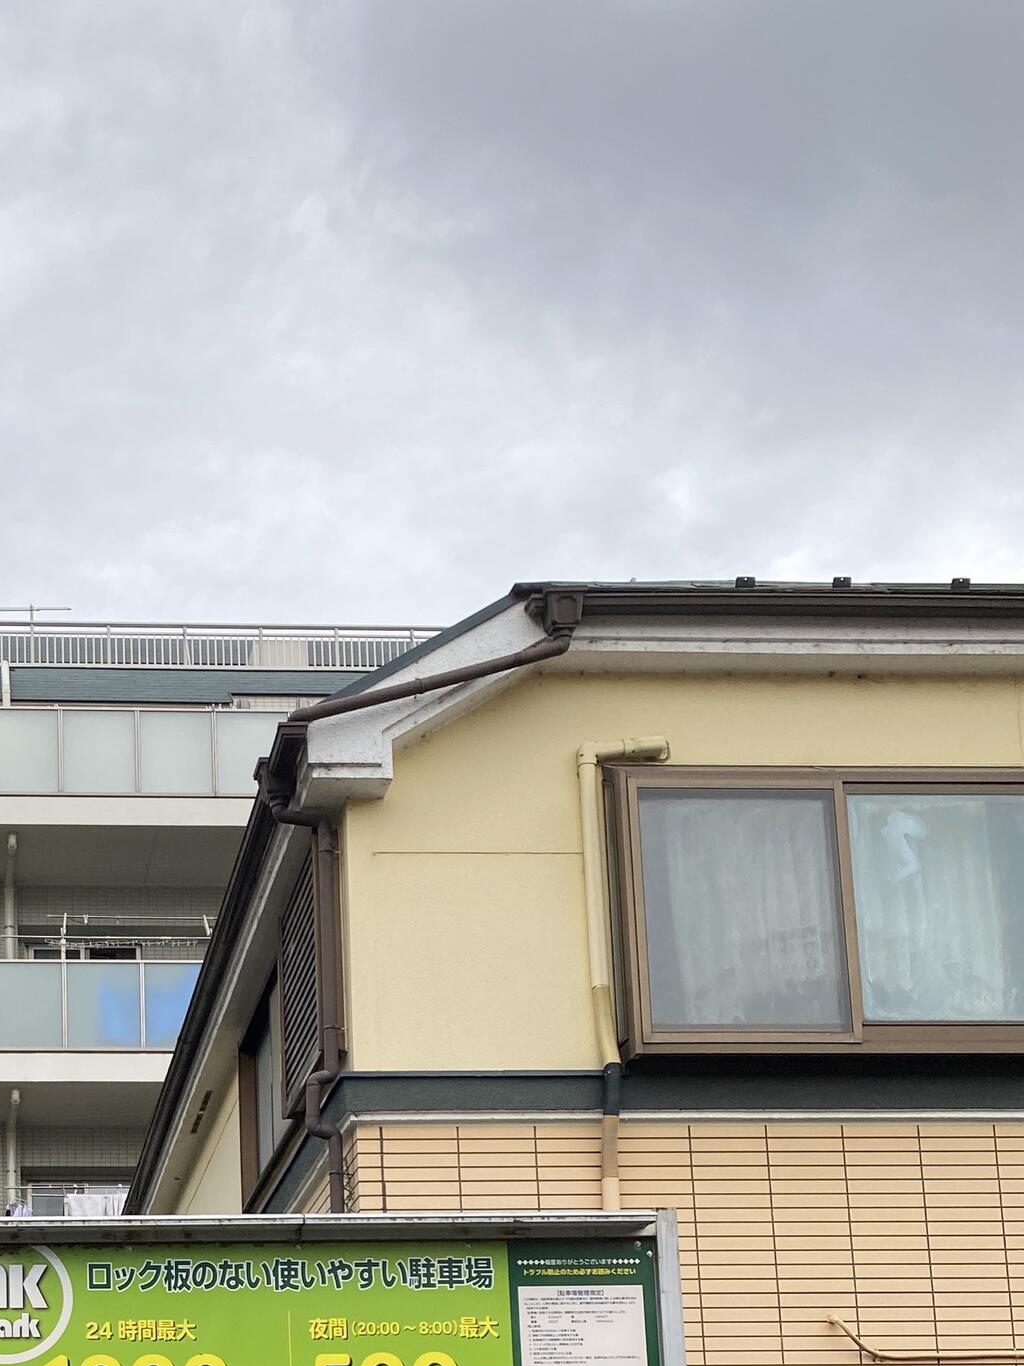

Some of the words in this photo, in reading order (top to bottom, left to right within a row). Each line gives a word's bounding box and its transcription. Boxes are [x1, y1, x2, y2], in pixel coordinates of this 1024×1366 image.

[87, 1256, 494, 1292] ロック板のない使いやすい駐車場
[86, 1320, 114, 1341] 24
[118, 1319, 197, 1342] 時間最大
